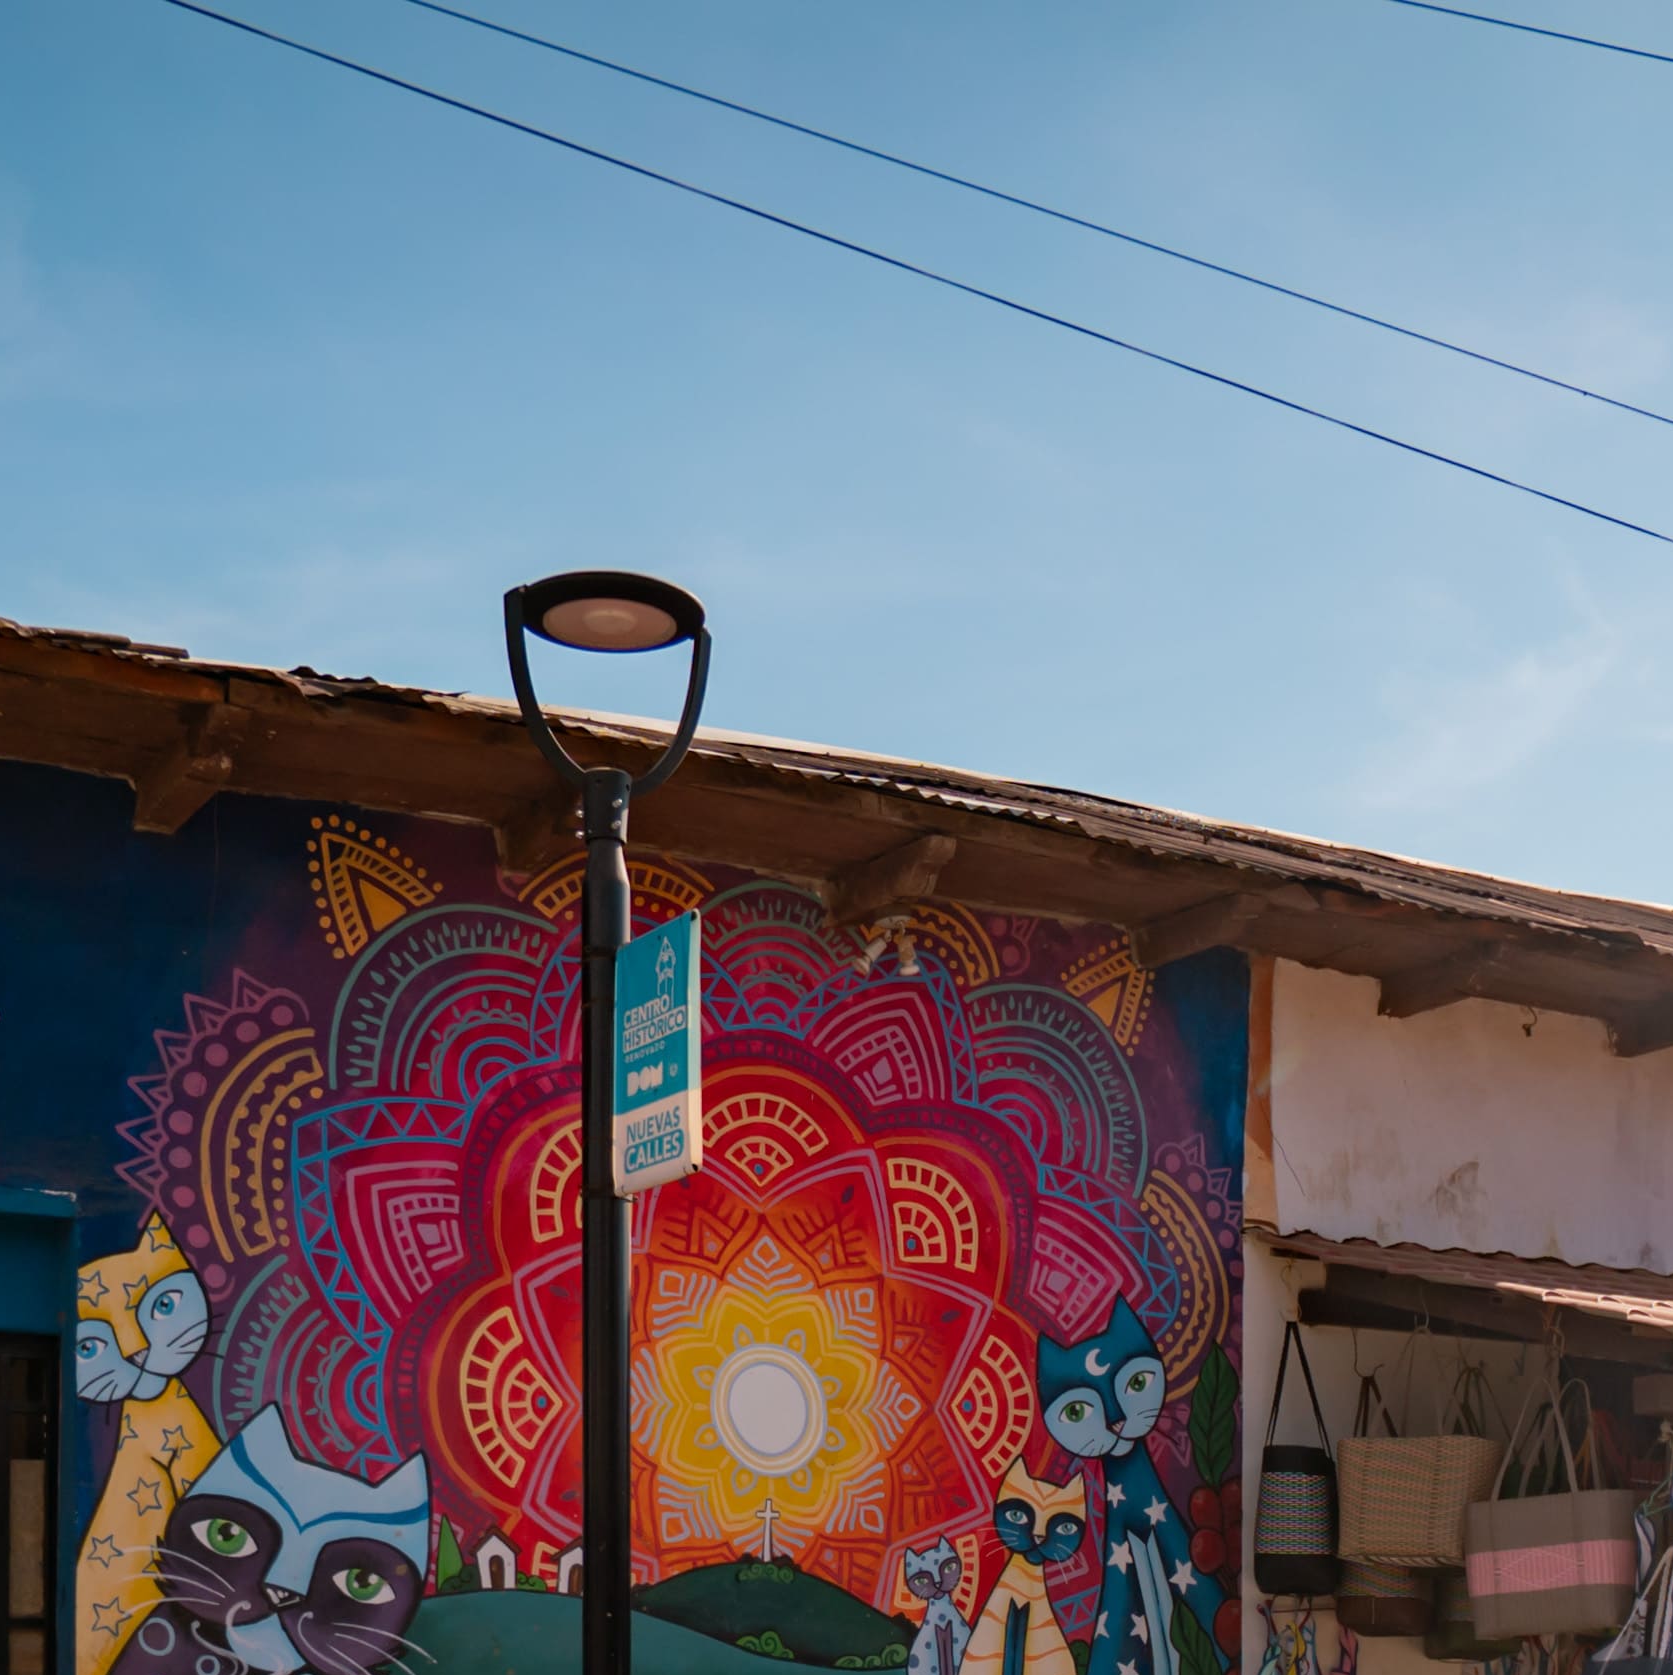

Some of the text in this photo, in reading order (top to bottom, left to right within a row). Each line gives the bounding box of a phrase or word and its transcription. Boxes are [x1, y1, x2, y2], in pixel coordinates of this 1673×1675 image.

[624, 994, 671, 1028] CENTRO
[627, 1061, 664, 1097] DOM
[626, 1106, 681, 1145] NUEVAS
[626, 1131, 683, 1171] CALLES
